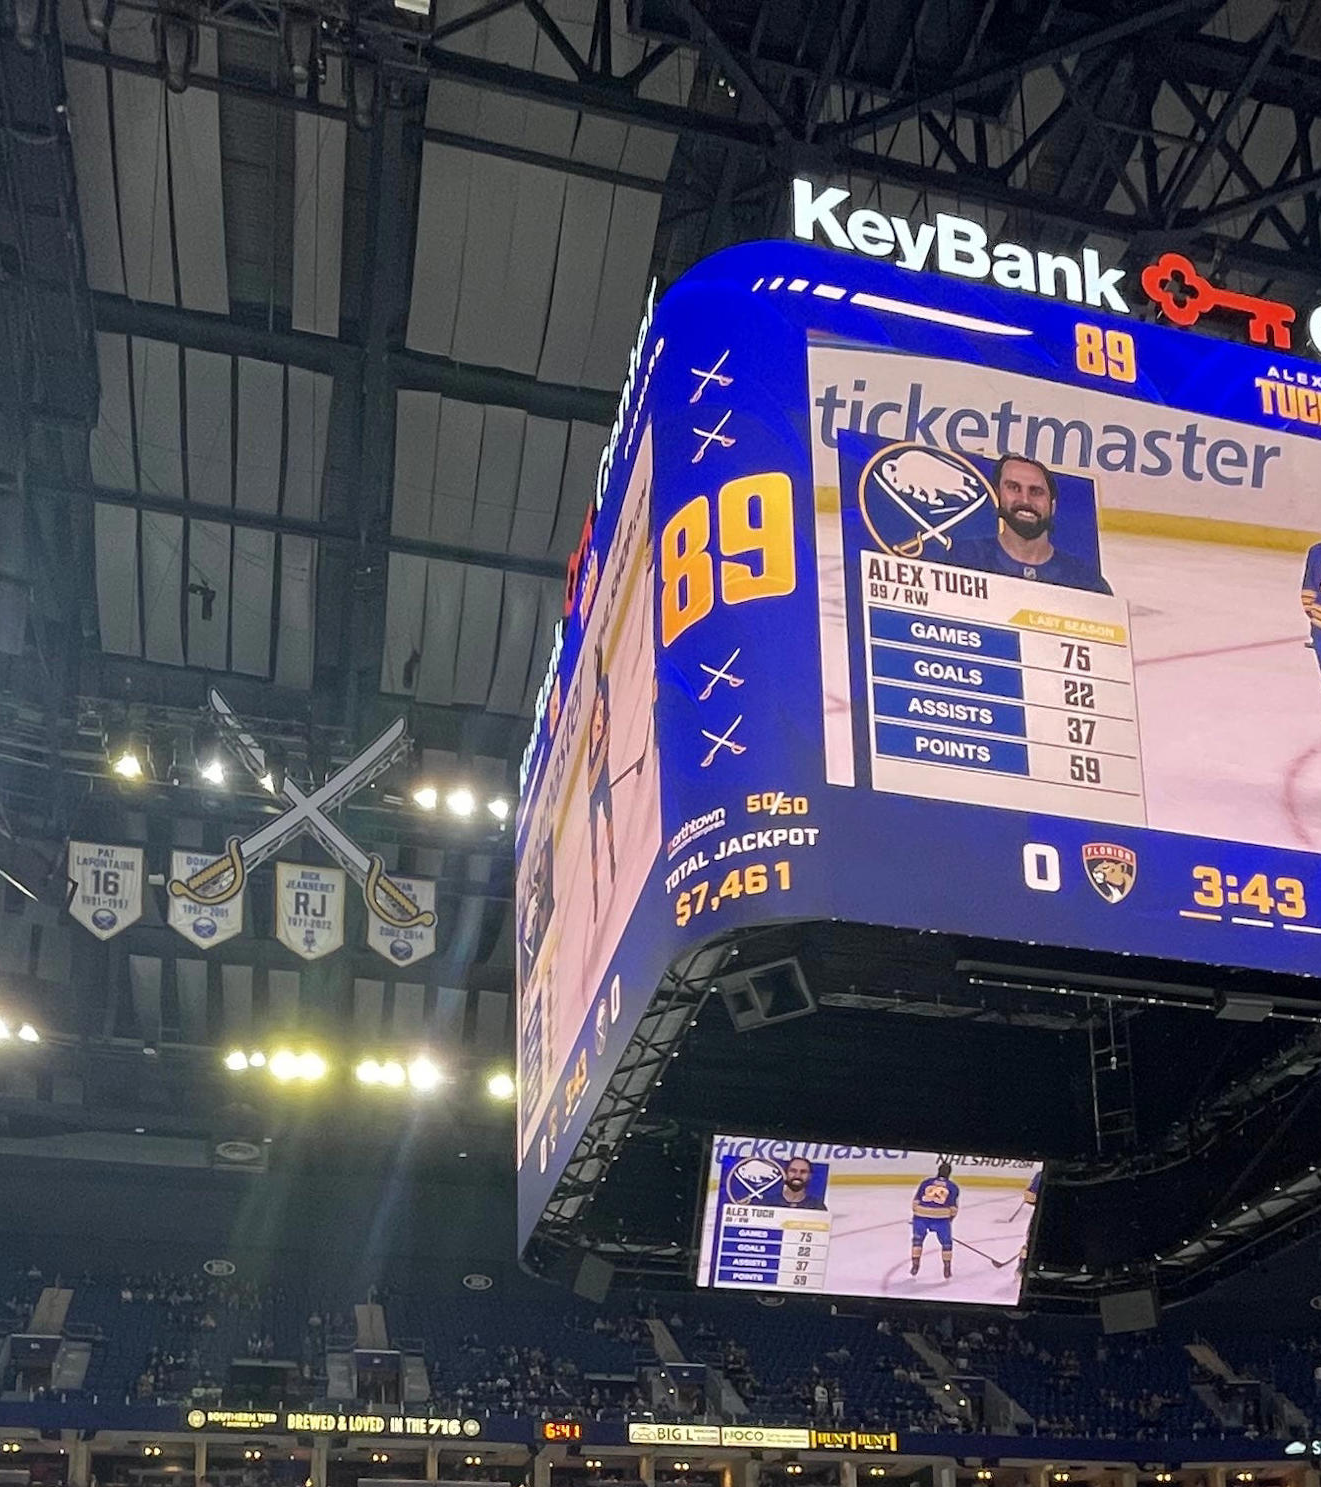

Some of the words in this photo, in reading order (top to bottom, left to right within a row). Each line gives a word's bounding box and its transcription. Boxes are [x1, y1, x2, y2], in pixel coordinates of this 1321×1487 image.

[791, 178, 1131, 313] KeyBank
[1075, 323, 1136, 383] 89
[816, 380, 1280, 489] ticketmaster
[661, 472, 797, 648] 89
[869, 558, 923, 587] ALEX
[931, 568, 988, 599] TUCH
[870, 583, 888, 599] 89
[905, 589, 928, 606] RW
[911, 622, 982, 647] GAMES
[1060, 642, 1090, 671] 75
[914, 661, 982, 685] GOALS
[1064, 680, 1094, 709] 22
[908, 698, 993, 724] ASSISTS
[1068, 717, 1095, 745] 37
[916, 736, 991, 761] POINTS
[1070, 755, 1100, 784] 59
[747, 792, 808, 815] 50/50
[98, 848, 114, 857] PAT
[664, 852, 709, 894] TOTAL
[714, 828, 819, 861] JACKPOT
[1023, 843, 1061, 892] 0
[92, 870, 120, 896] 16
[676, 861, 791, 927] $7,461
[1192, 865, 1306, 919] 3:43
[295, 892, 326, 917] RJ
[726, 1207, 749, 1217] ALEX
[751, 1209, 774, 1219] TUCH
[800, 1232, 812, 1242] 75
[797, 1247, 811, 1257] 22
[796, 1261, 809, 1271] 37
[794, 1275, 807, 1286] 59
[287, 1414, 335, 1430] BREWED
[337, 1415, 348, 1430] &
[349, 1415, 384, 1432] LOVED
[390, 1417, 403, 1432] IN
[405, 1417, 427, 1433] THE
[428, 1419, 460, 1434] 716
[657, 1428, 681, 1440] BIG
[818, 1433, 849, 1444] HUNT
[858, 1433, 890, 1445] HUNT
